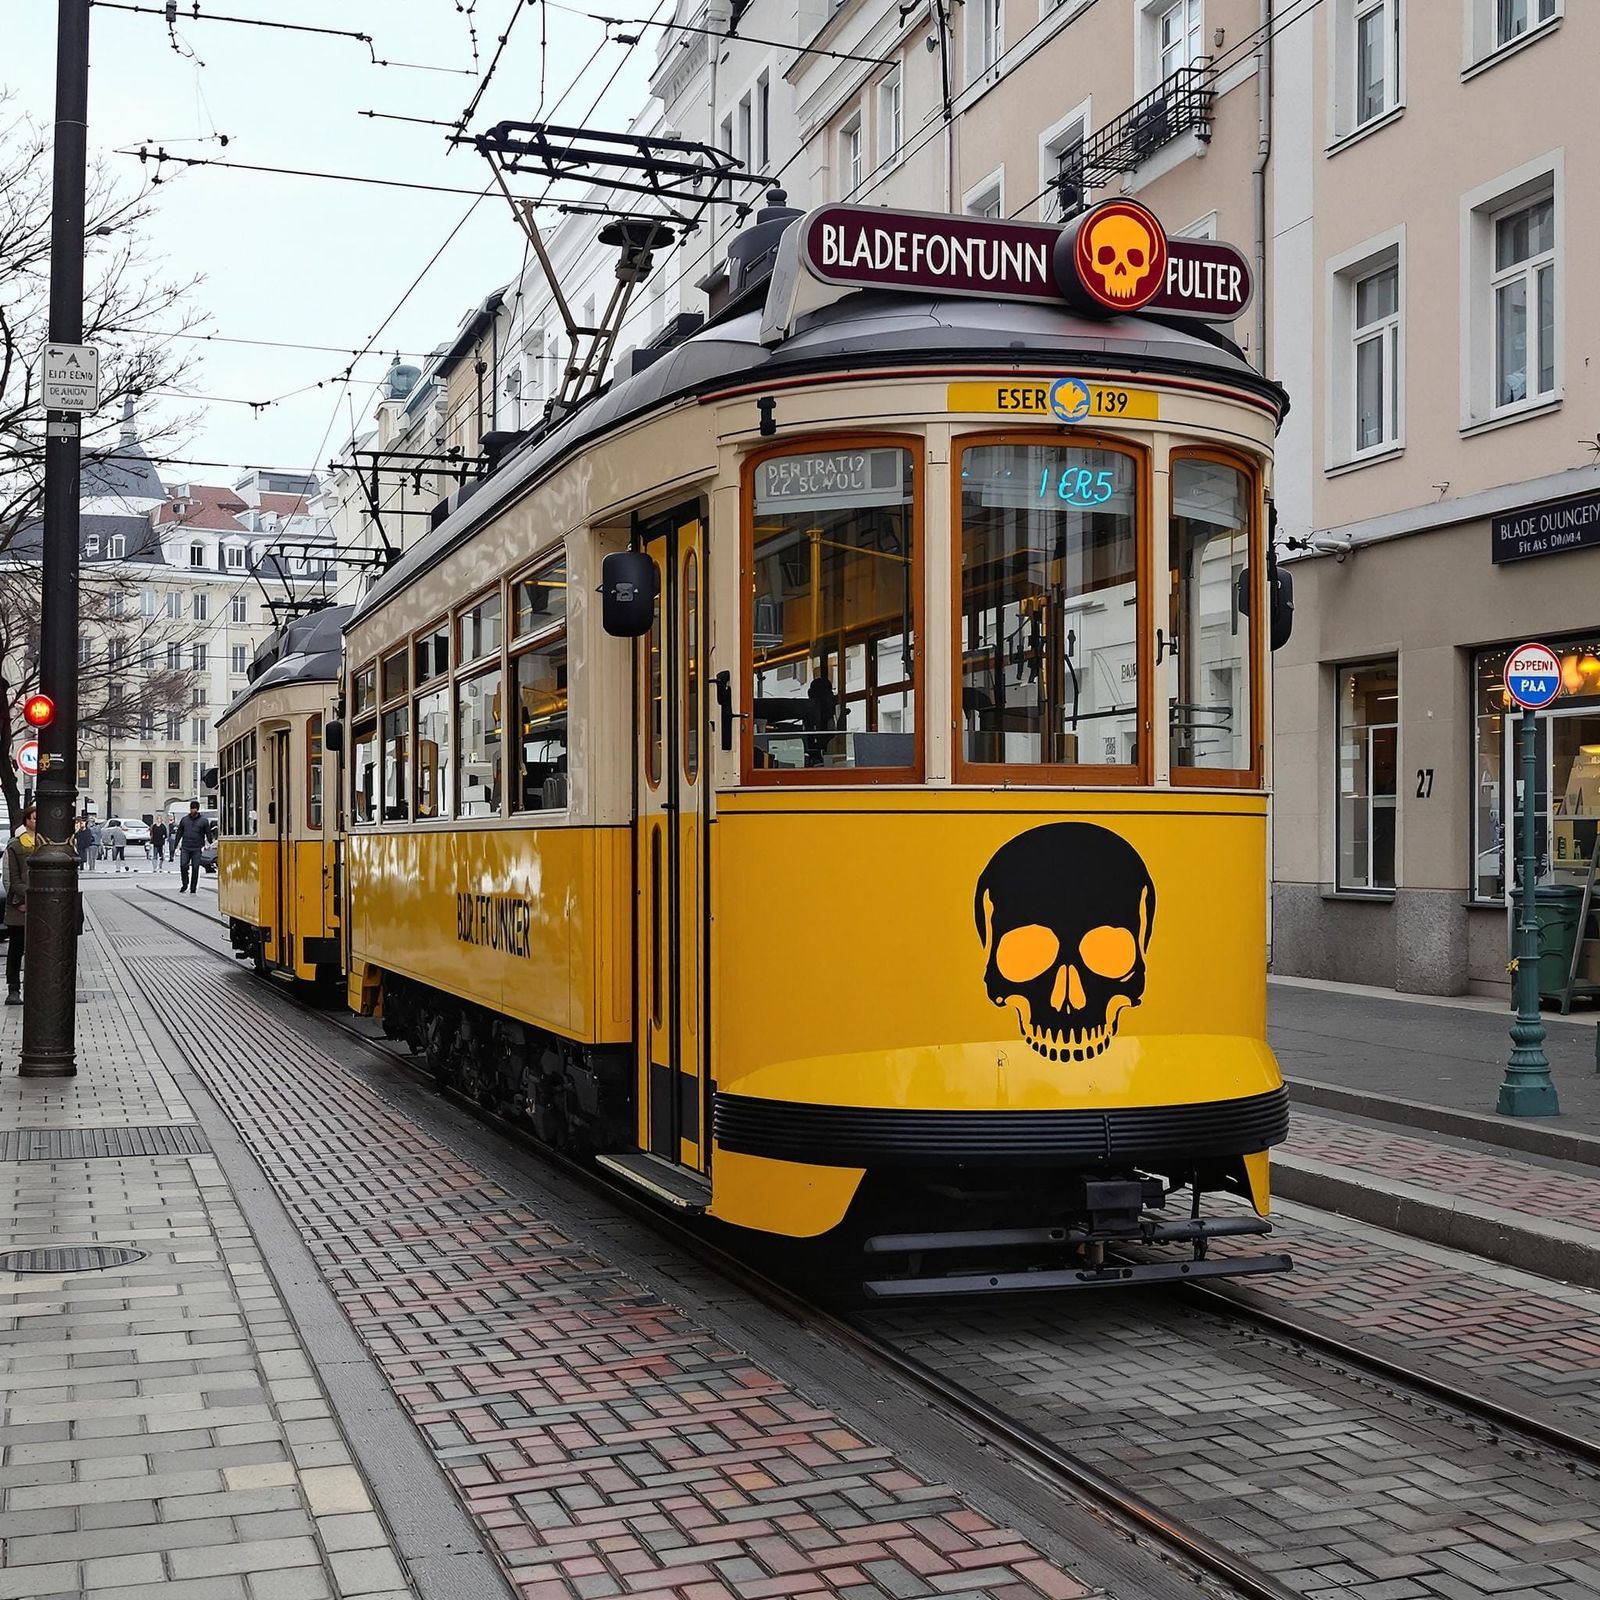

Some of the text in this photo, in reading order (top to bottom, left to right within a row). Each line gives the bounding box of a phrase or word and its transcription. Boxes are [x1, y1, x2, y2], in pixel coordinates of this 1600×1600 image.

[1166, 257, 1242, 303] FULTER
[997, 388, 1129, 413] ESER 139
[1500, 517, 1538, 540] BLADE
[1416, 768, 1435, 799] 27
